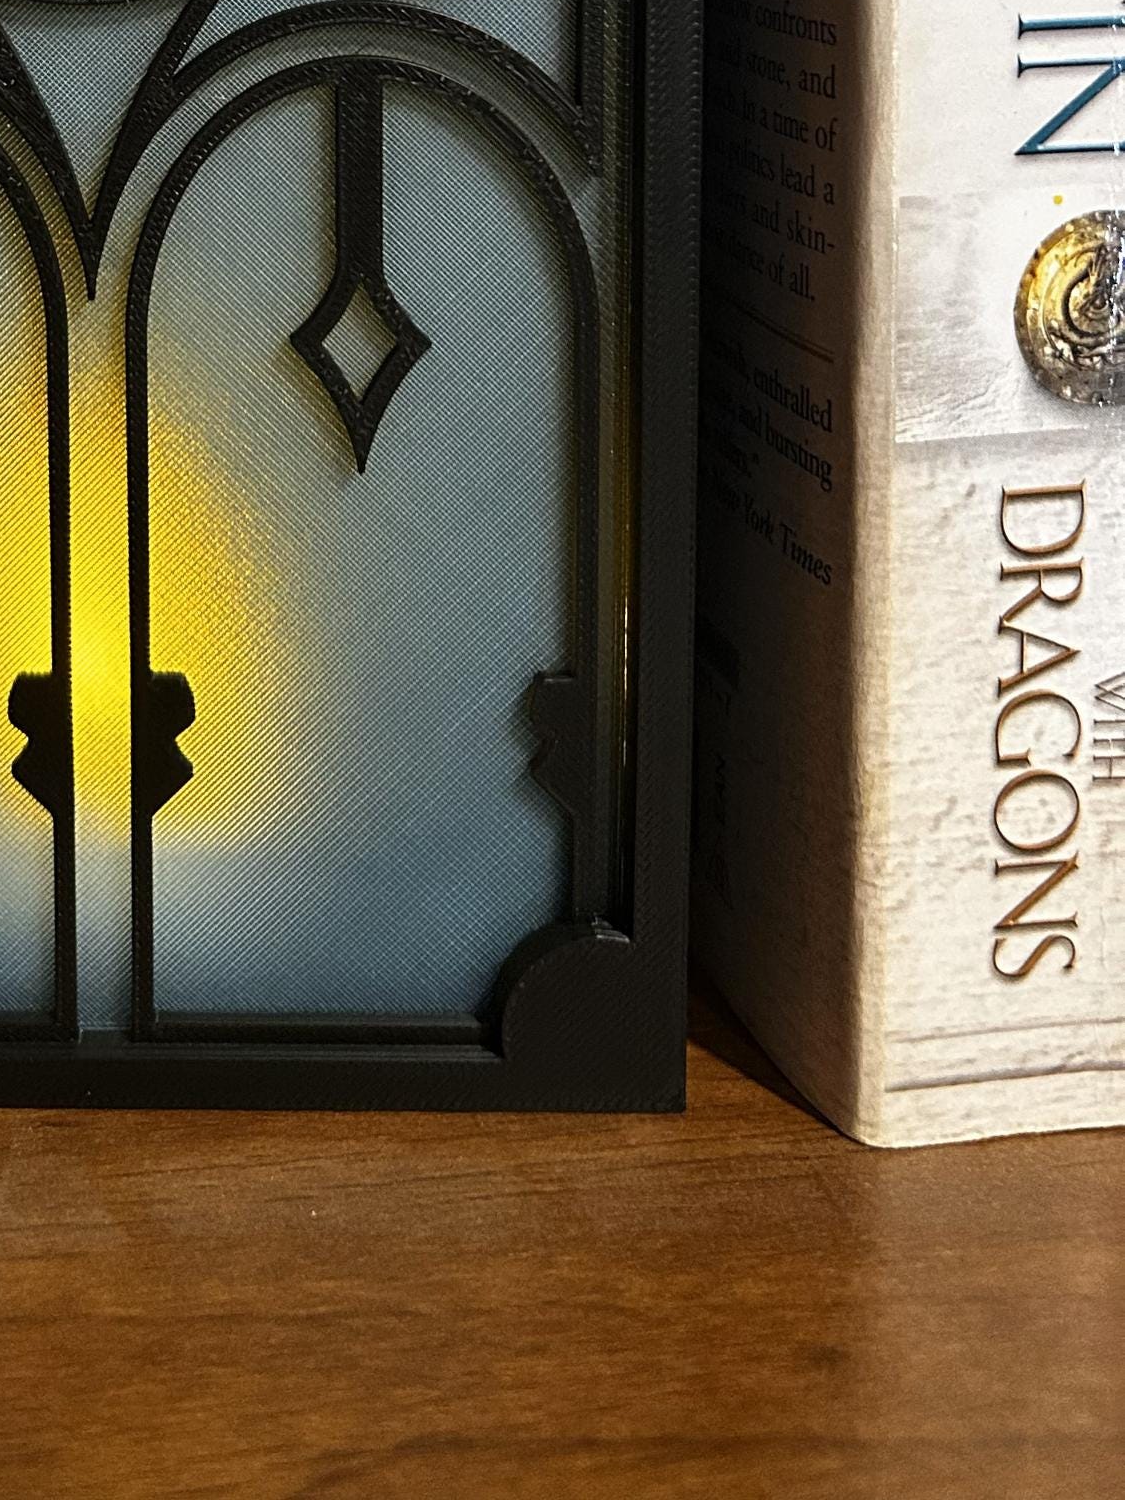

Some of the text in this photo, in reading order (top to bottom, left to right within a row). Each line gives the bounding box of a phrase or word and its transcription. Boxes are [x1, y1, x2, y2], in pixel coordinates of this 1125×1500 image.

[797, 63, 837, 100] and
[773, 102, 810, 146] time
[814, 117, 838, 153] of
[779, 152, 816, 199] lead
[823, 180, 836, 206] a
[751, 198, 781, 235] and
[786, 208, 836, 255] skin-
[768, 252, 786, 287] of
[789, 263, 816, 302] all.
[753, 366, 833, 435] enthralled
[764, 409, 833, 494] bursting
[743, 492, 776, 546] York
[778, 519, 833, 587] Times
[992, 478, 1087, 978] DRAGONS
